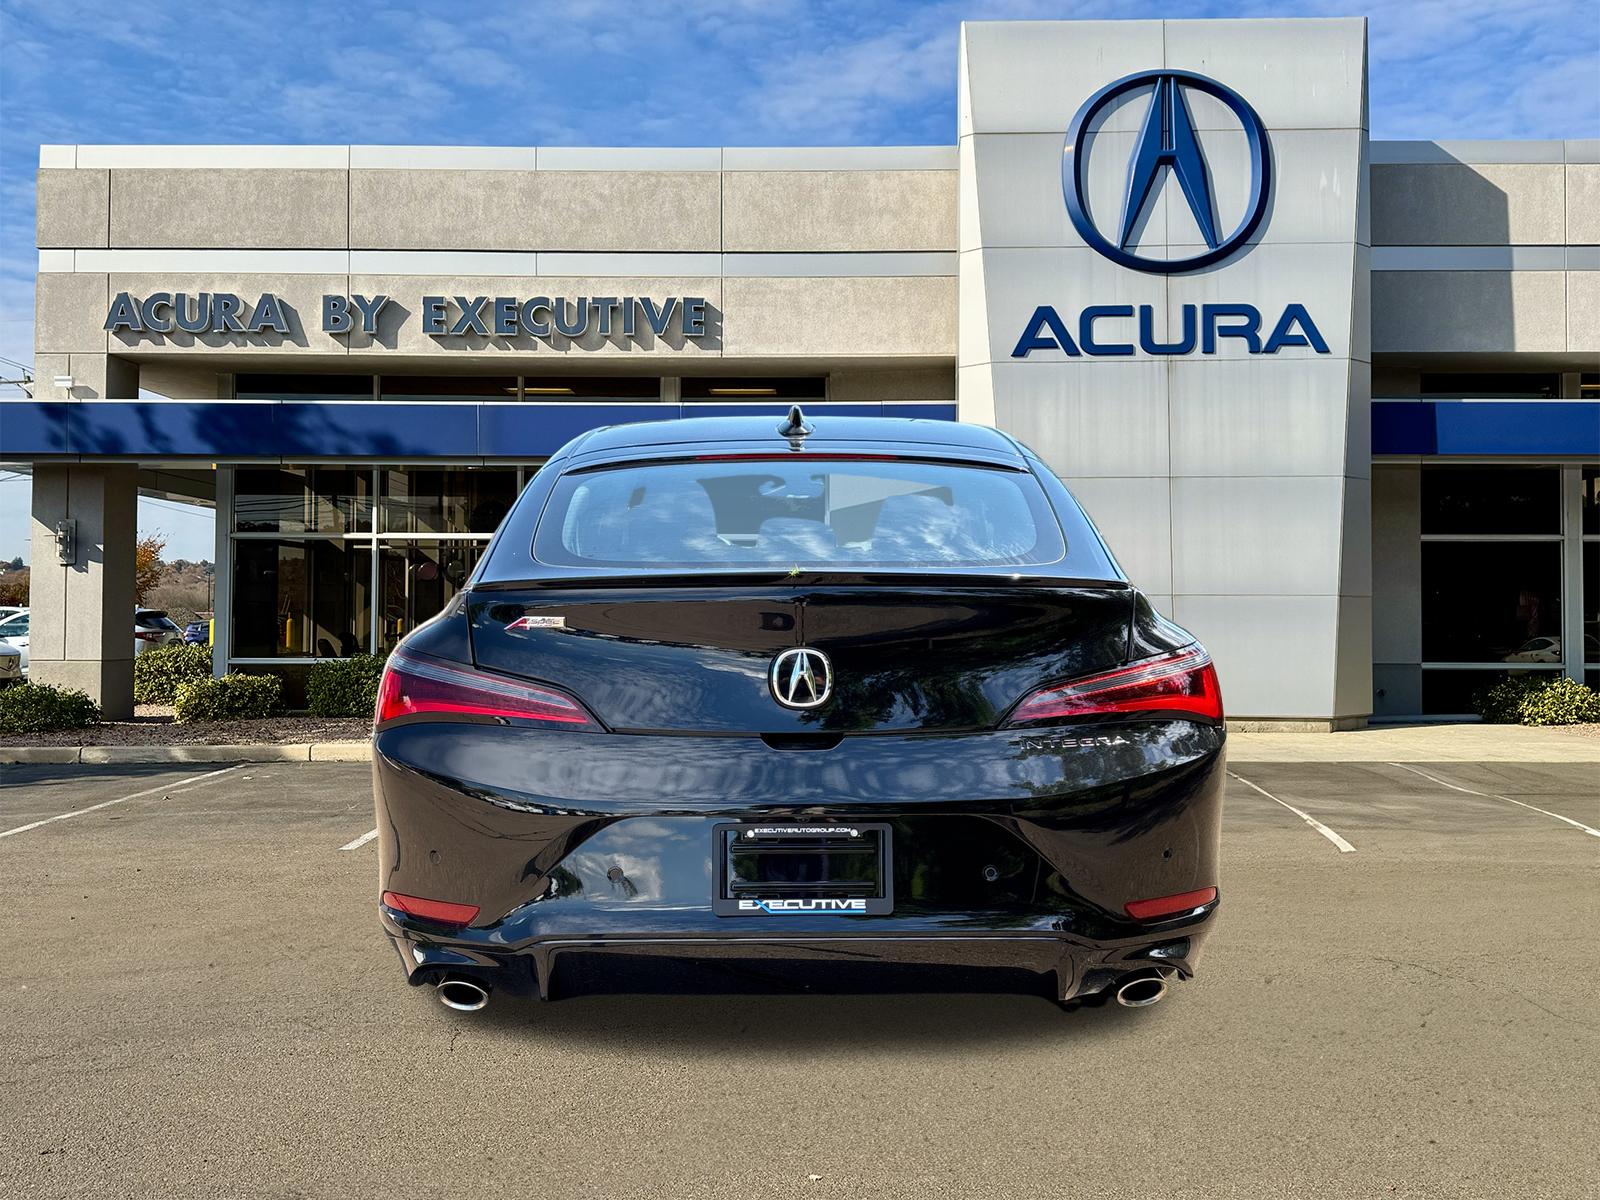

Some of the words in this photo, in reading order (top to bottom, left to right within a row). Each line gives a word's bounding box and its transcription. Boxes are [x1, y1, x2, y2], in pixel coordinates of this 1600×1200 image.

[105, 292, 290, 333] ACURA
[323, 294, 391, 333] BY
[423, 296, 706, 336] EXECUTIVE
[1011, 303, 1331, 357] ACURA
[1019, 735, 1130, 750] INTEGRA
[738, 899, 866, 913] EXECUTIVE
